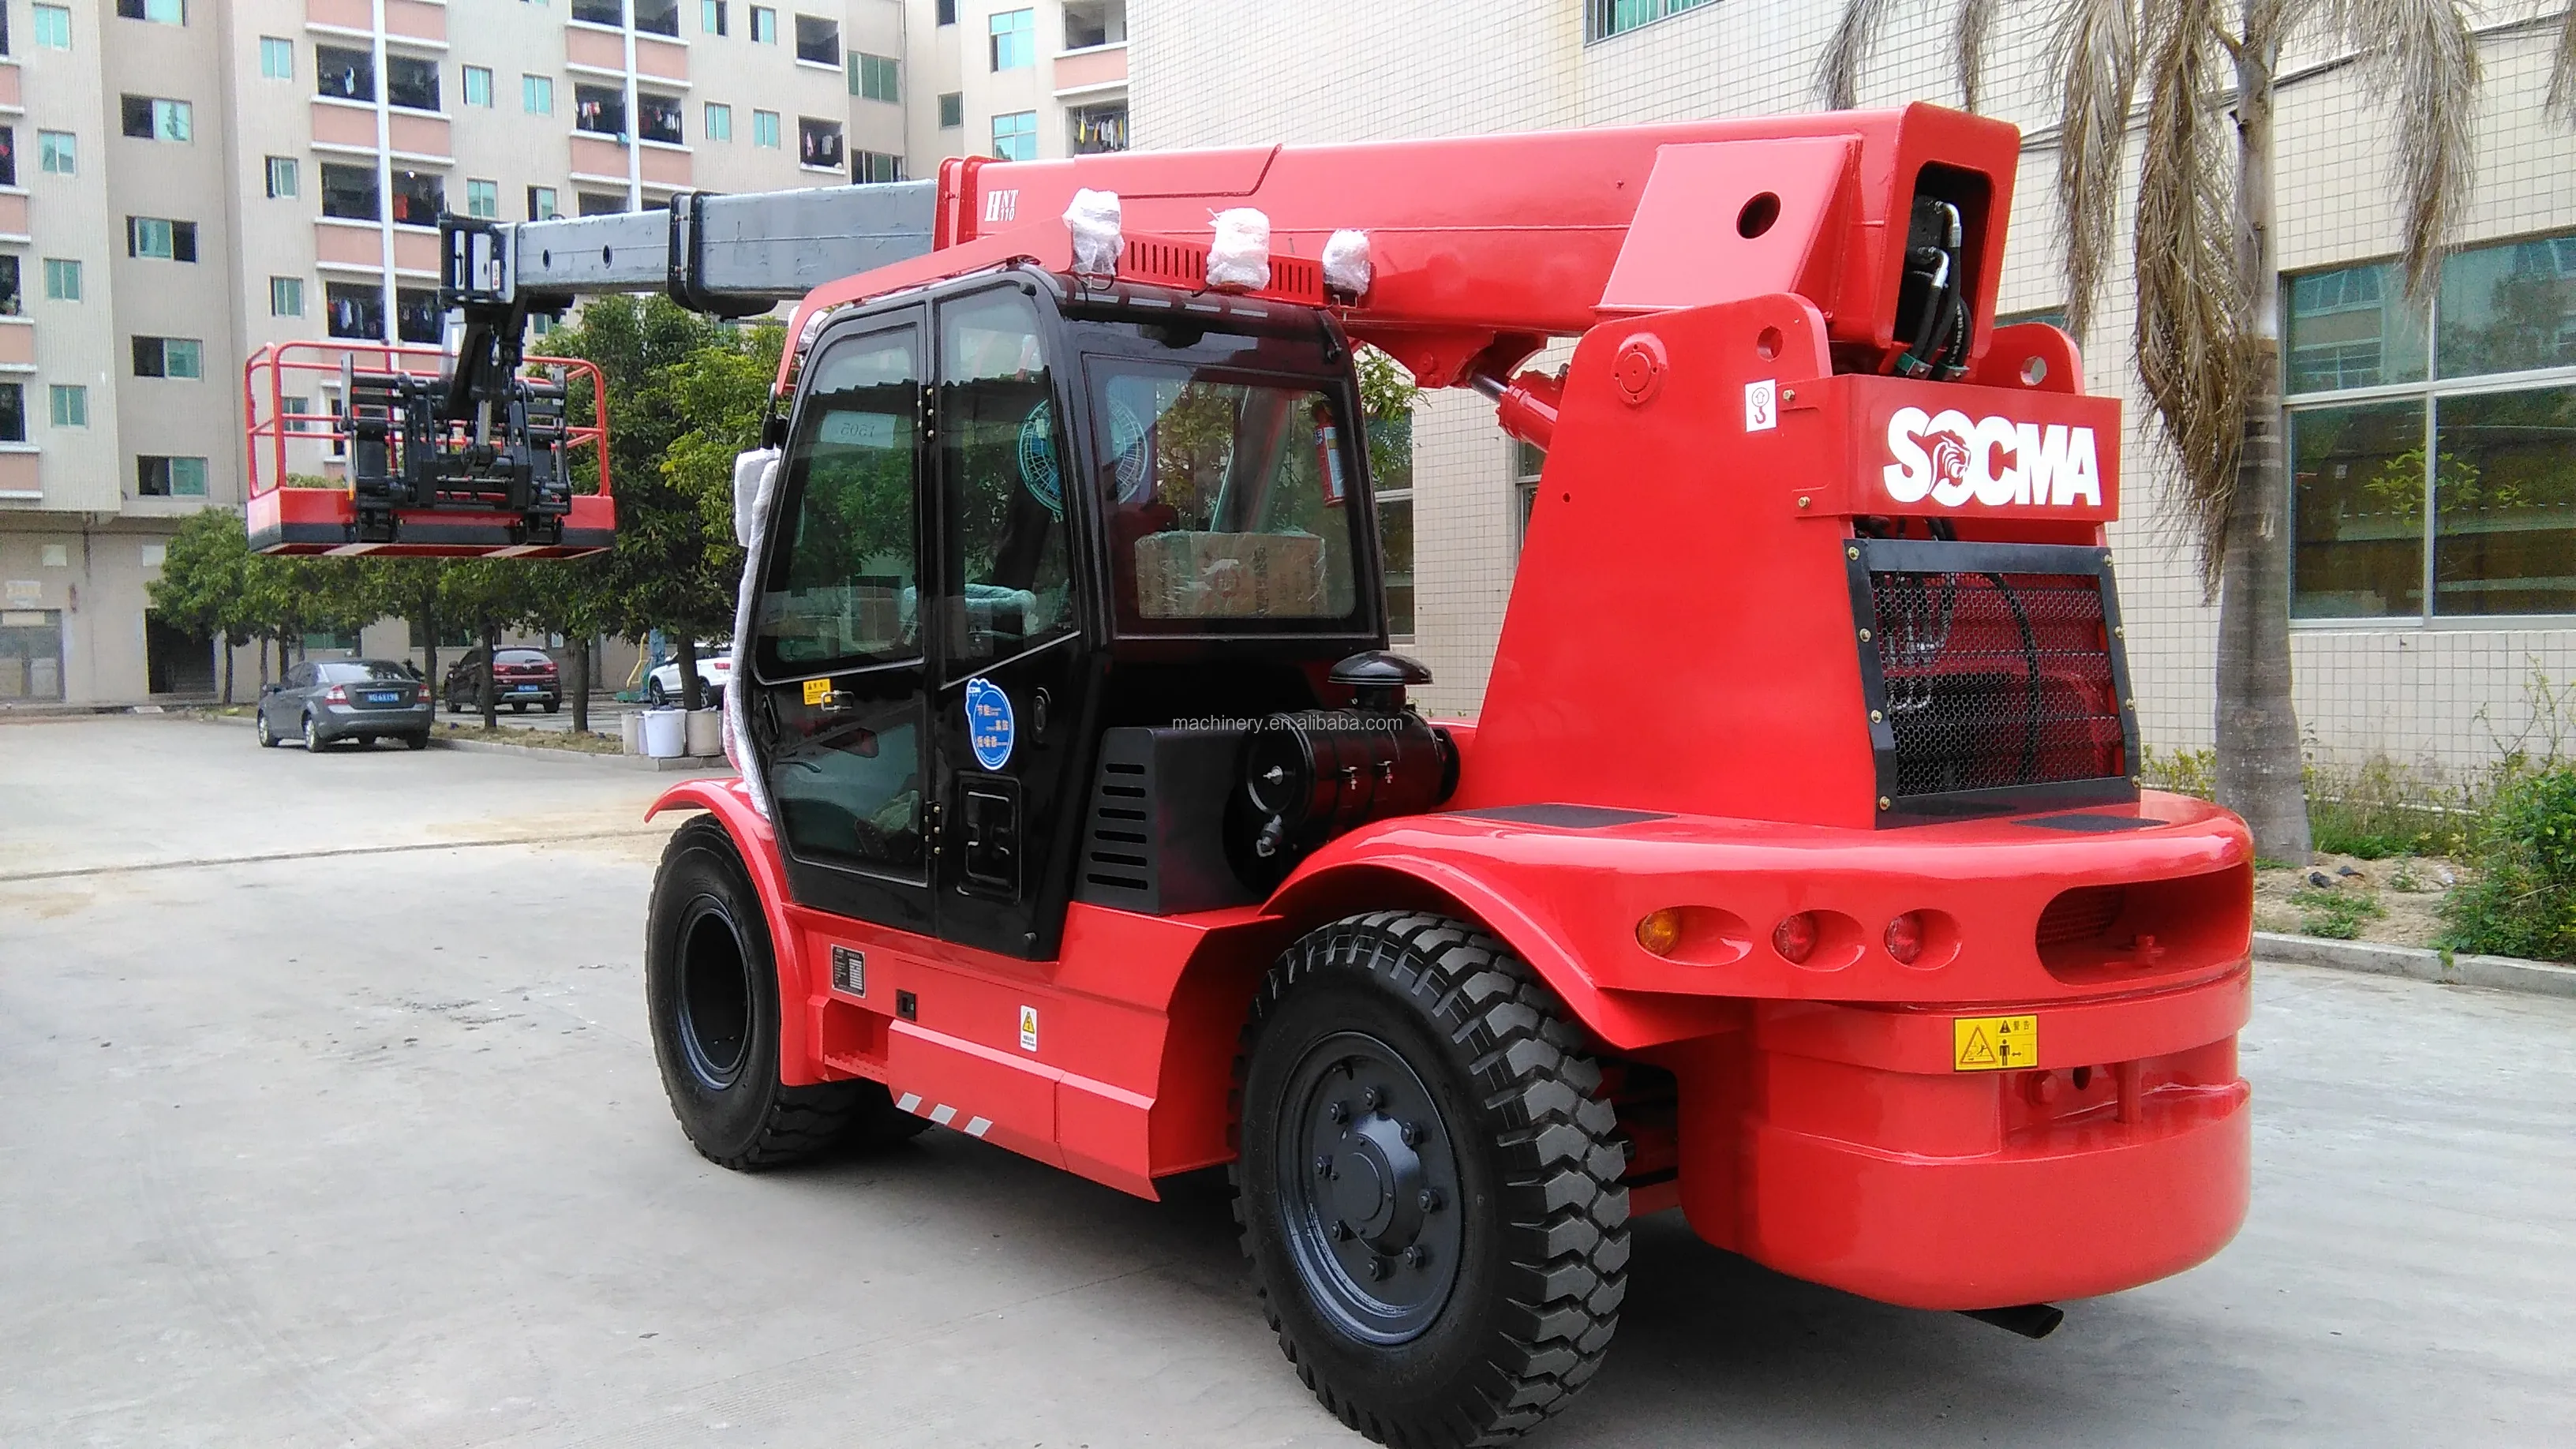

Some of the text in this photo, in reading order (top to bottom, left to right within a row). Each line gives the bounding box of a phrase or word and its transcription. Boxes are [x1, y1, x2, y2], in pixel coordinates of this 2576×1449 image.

[984, 189, 1019, 222] HNT
[1000, 208, 1015, 222] 110
[1883, 406, 2102, 507] SOCMA
